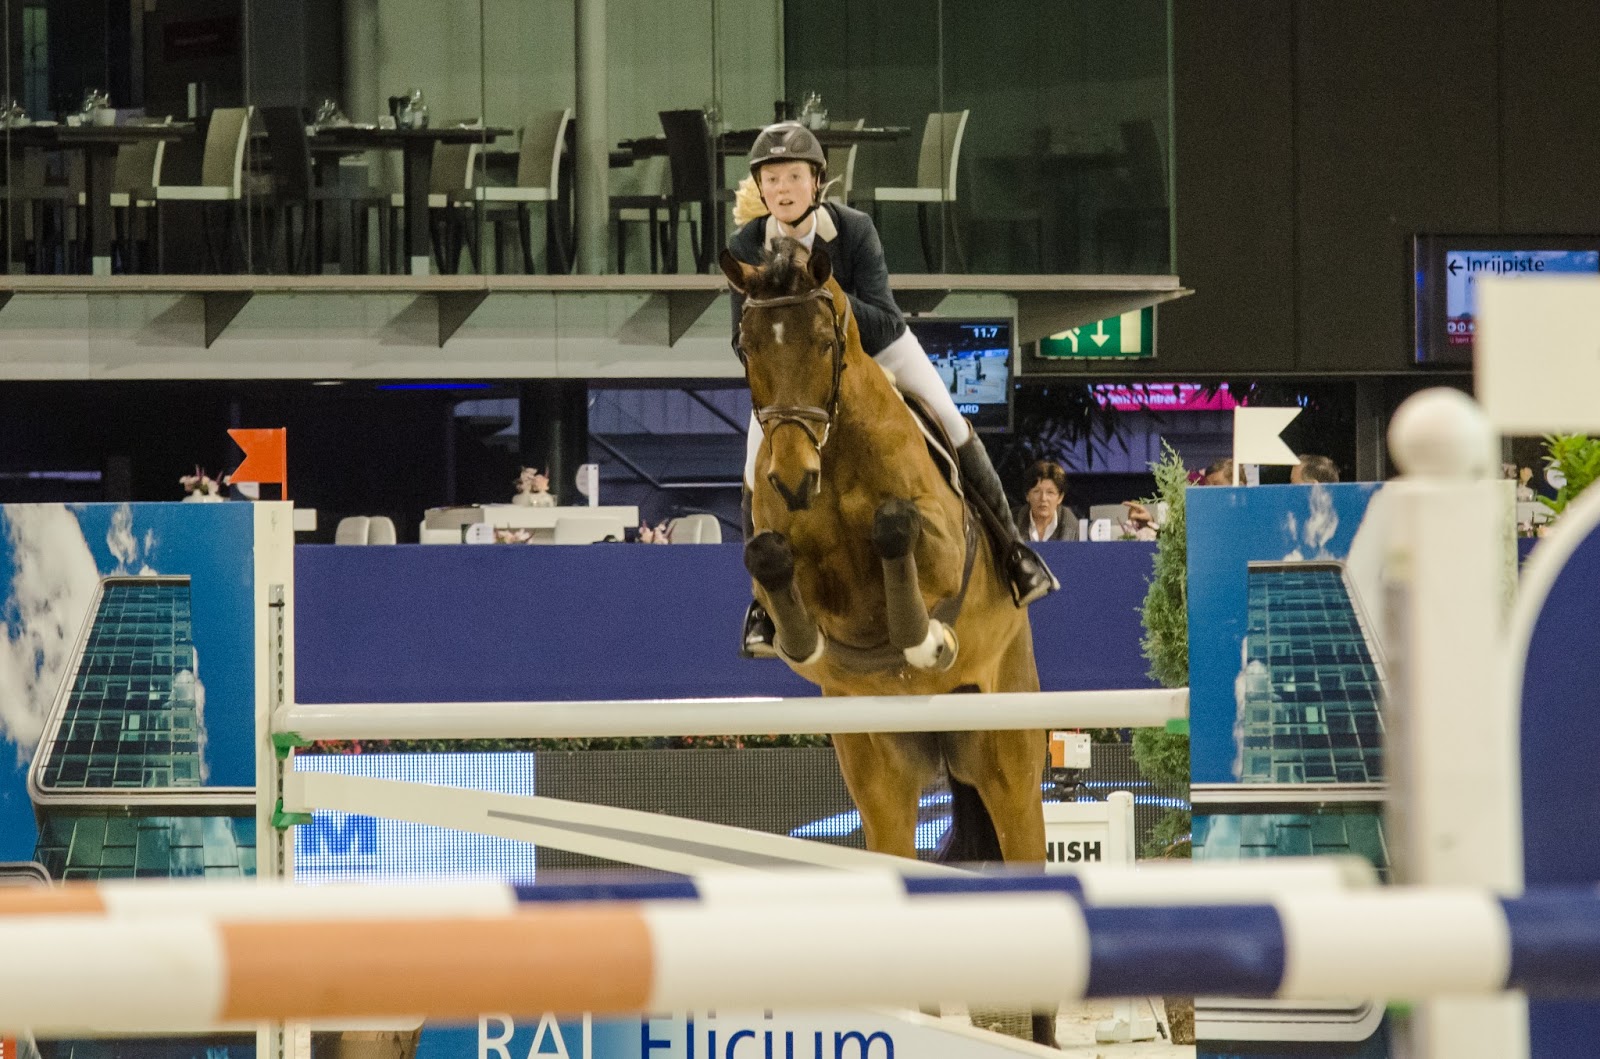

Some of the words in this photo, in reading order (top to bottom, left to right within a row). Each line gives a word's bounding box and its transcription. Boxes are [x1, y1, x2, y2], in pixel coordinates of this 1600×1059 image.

[1467, 256, 1544, 274] Inrijpiste
[973, 327, 998, 338] 11.7
[955, 404, 980, 414] ARD
[478, 1011, 592, 1059] RAI
[641, 1010, 895, 1059] Elicium
